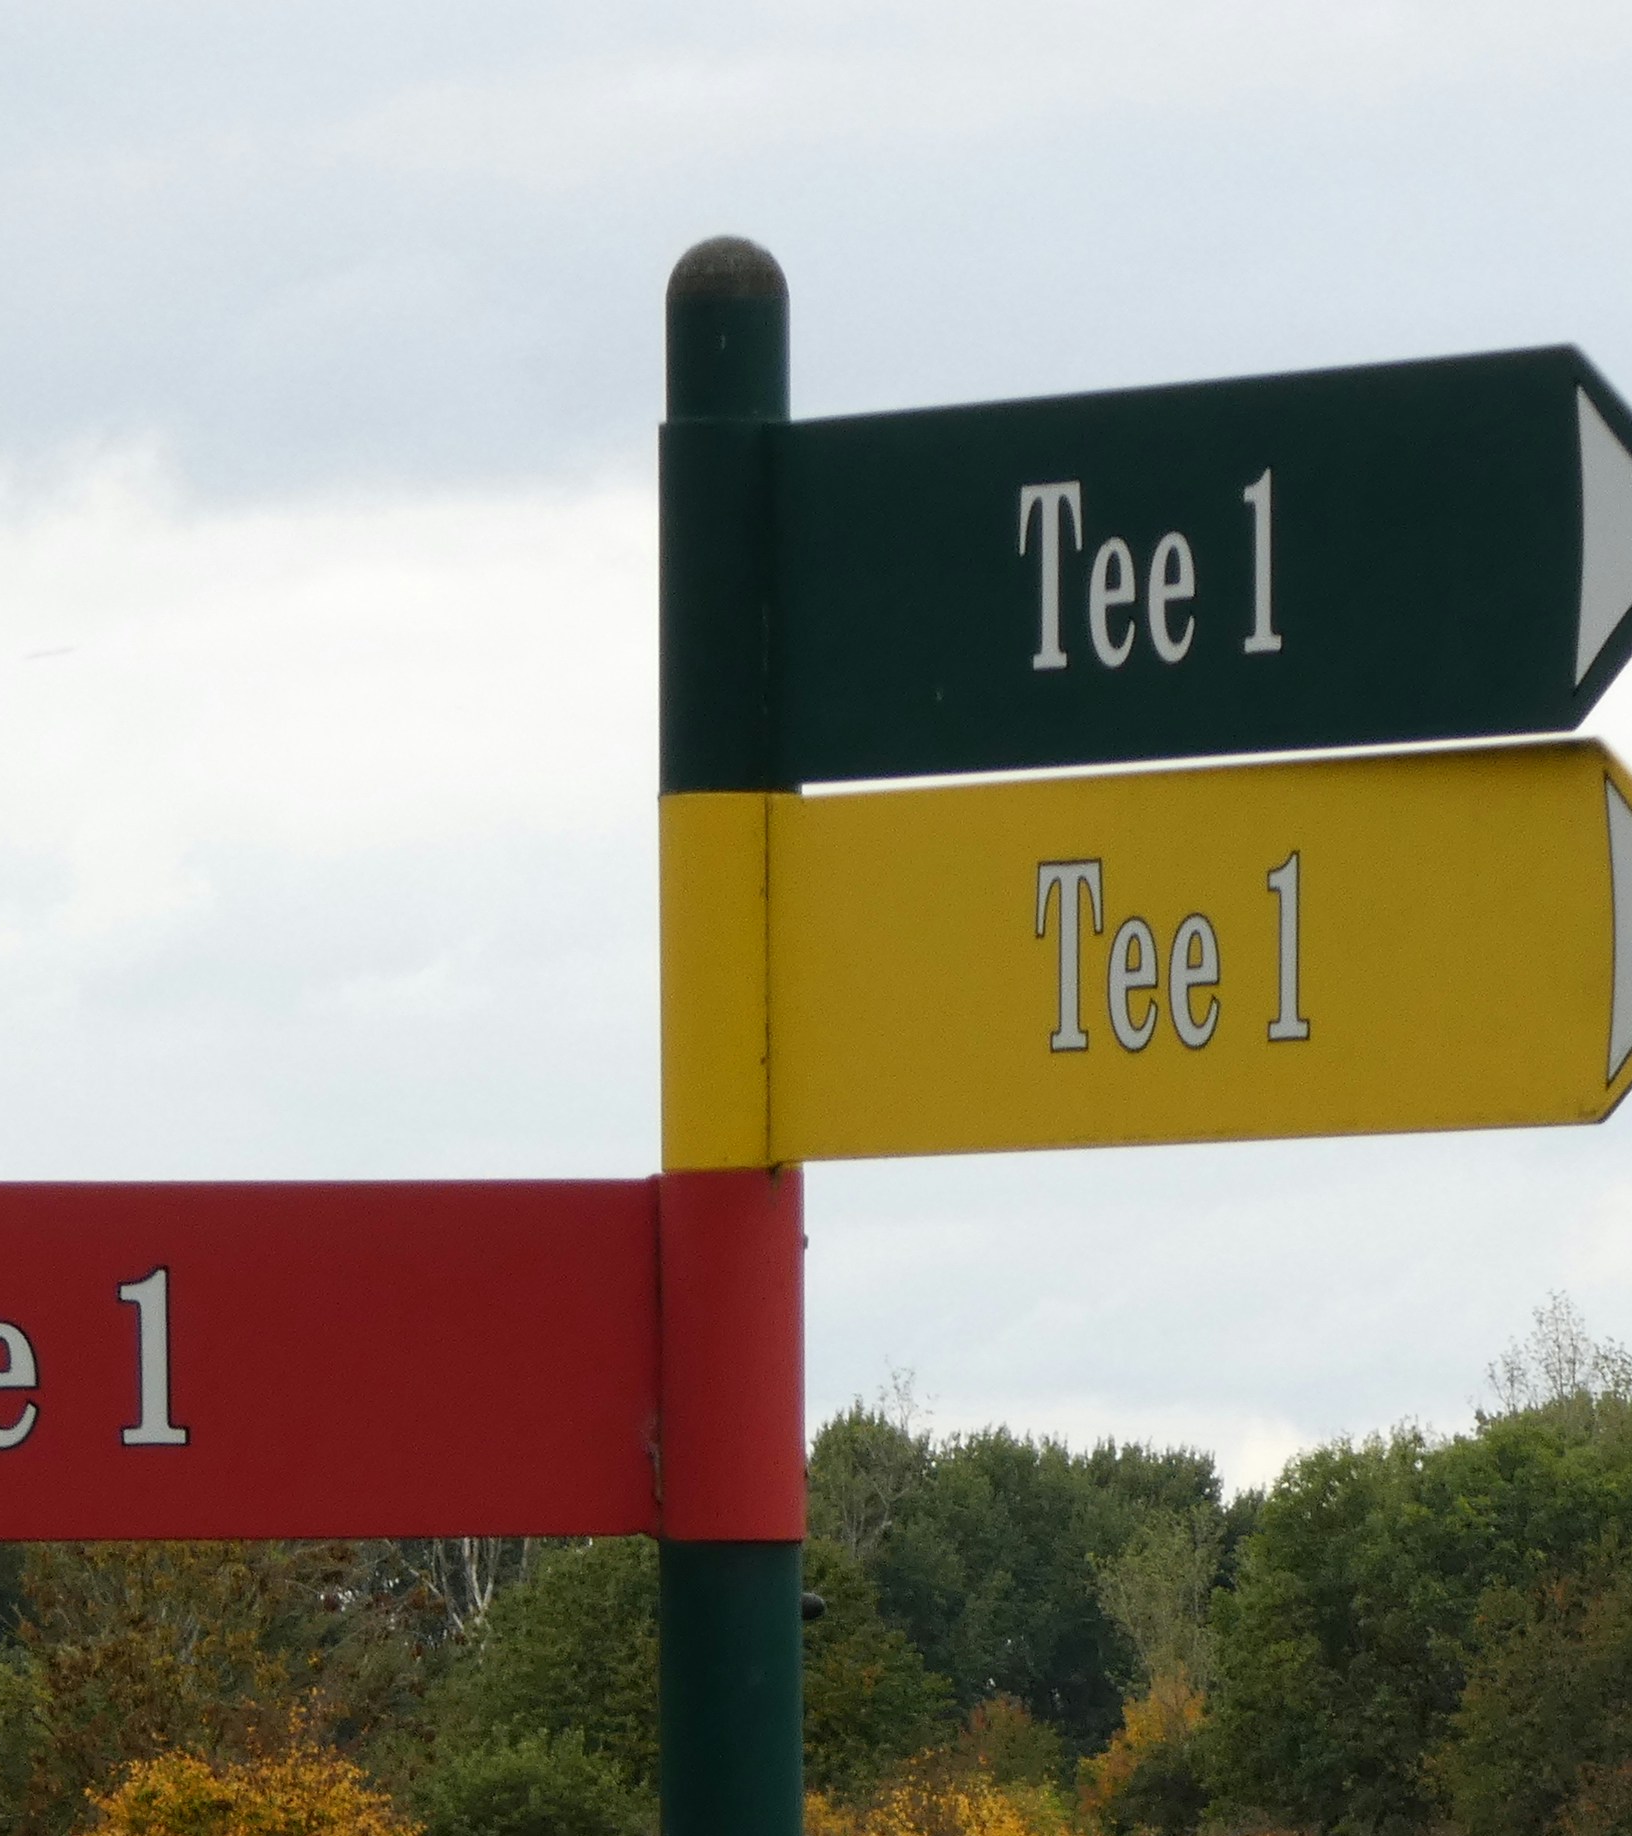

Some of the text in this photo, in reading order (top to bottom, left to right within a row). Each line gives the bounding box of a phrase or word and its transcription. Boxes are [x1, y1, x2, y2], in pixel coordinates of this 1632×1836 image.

[1018, 467, 1284, 671] Tee 1
[1035, 850, 1311, 1053] Tee 1
[116, 1265, 189, 1447] 1
